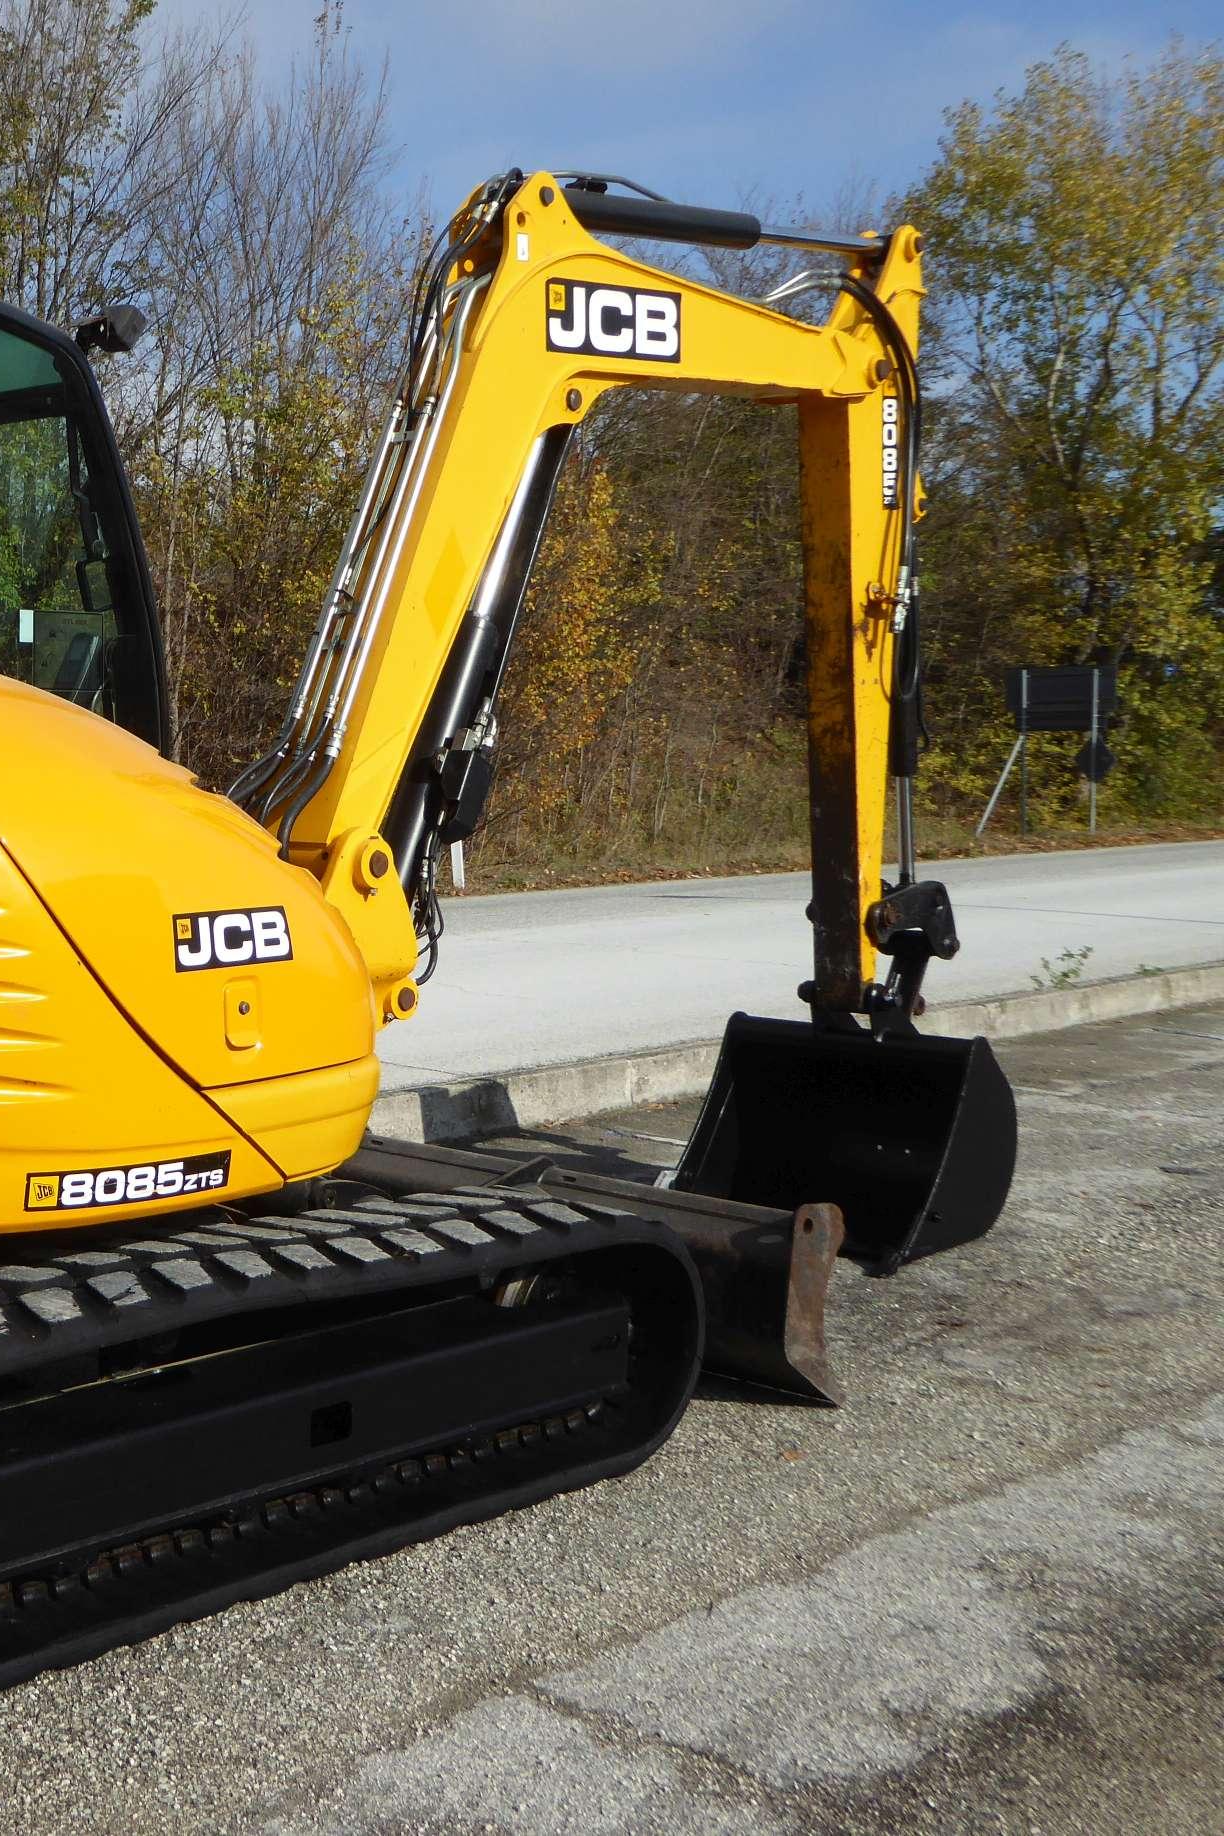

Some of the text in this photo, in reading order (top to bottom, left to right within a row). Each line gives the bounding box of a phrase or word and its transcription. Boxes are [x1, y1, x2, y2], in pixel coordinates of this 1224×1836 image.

[549, 287, 678, 357] JCB
[178, 910, 290, 966] JCB
[36, 1184, 54, 1200] JCB
